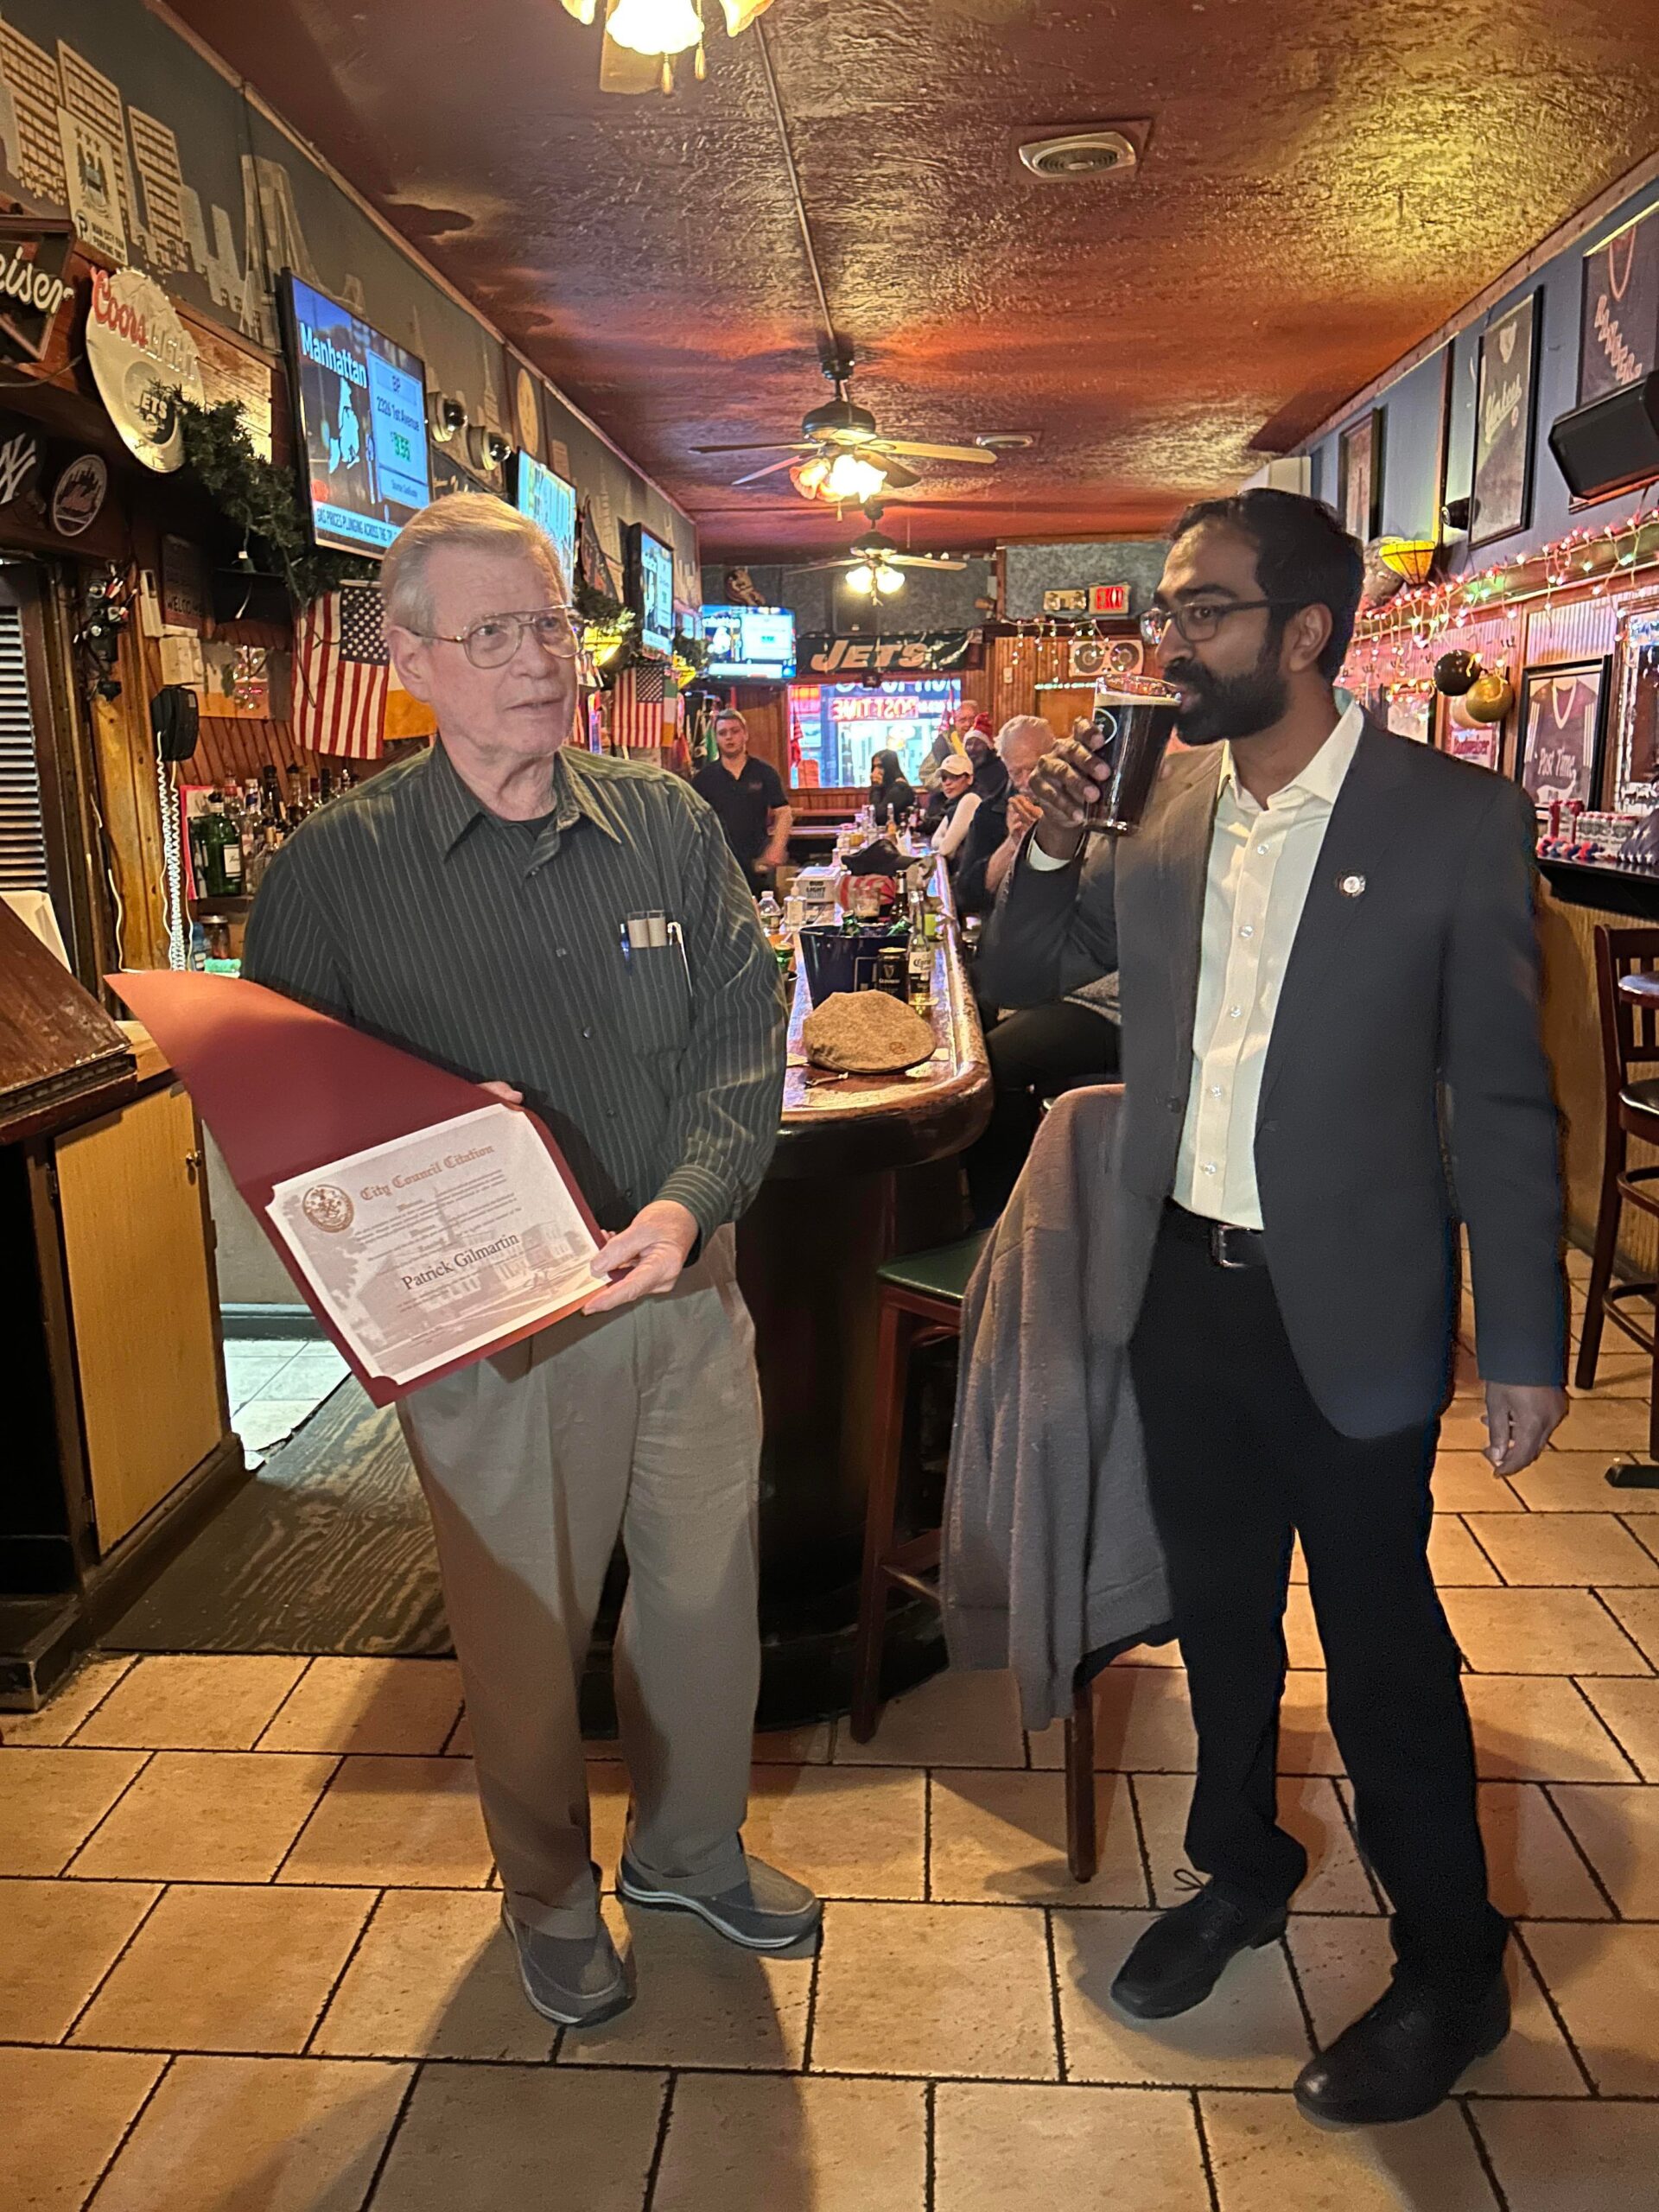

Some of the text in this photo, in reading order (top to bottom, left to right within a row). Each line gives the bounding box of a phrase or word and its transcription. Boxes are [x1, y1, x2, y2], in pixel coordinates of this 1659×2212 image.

[90, 264, 149, 349] Coors
[299, 321, 367, 389] Manhattan
[1593, 295, 1643, 386] RANGERS
[136, 391, 168, 420] ETS
[1484, 372, 1522, 444] Yankees
[1096, 586, 1123, 610] EXIT
[810, 639, 928, 671] JETS
[359, 1145, 495, 1201] City Council Citation
[401, 1261, 454, 1290] Patrick
[454, 1234, 520, 1268] Gilmartin
